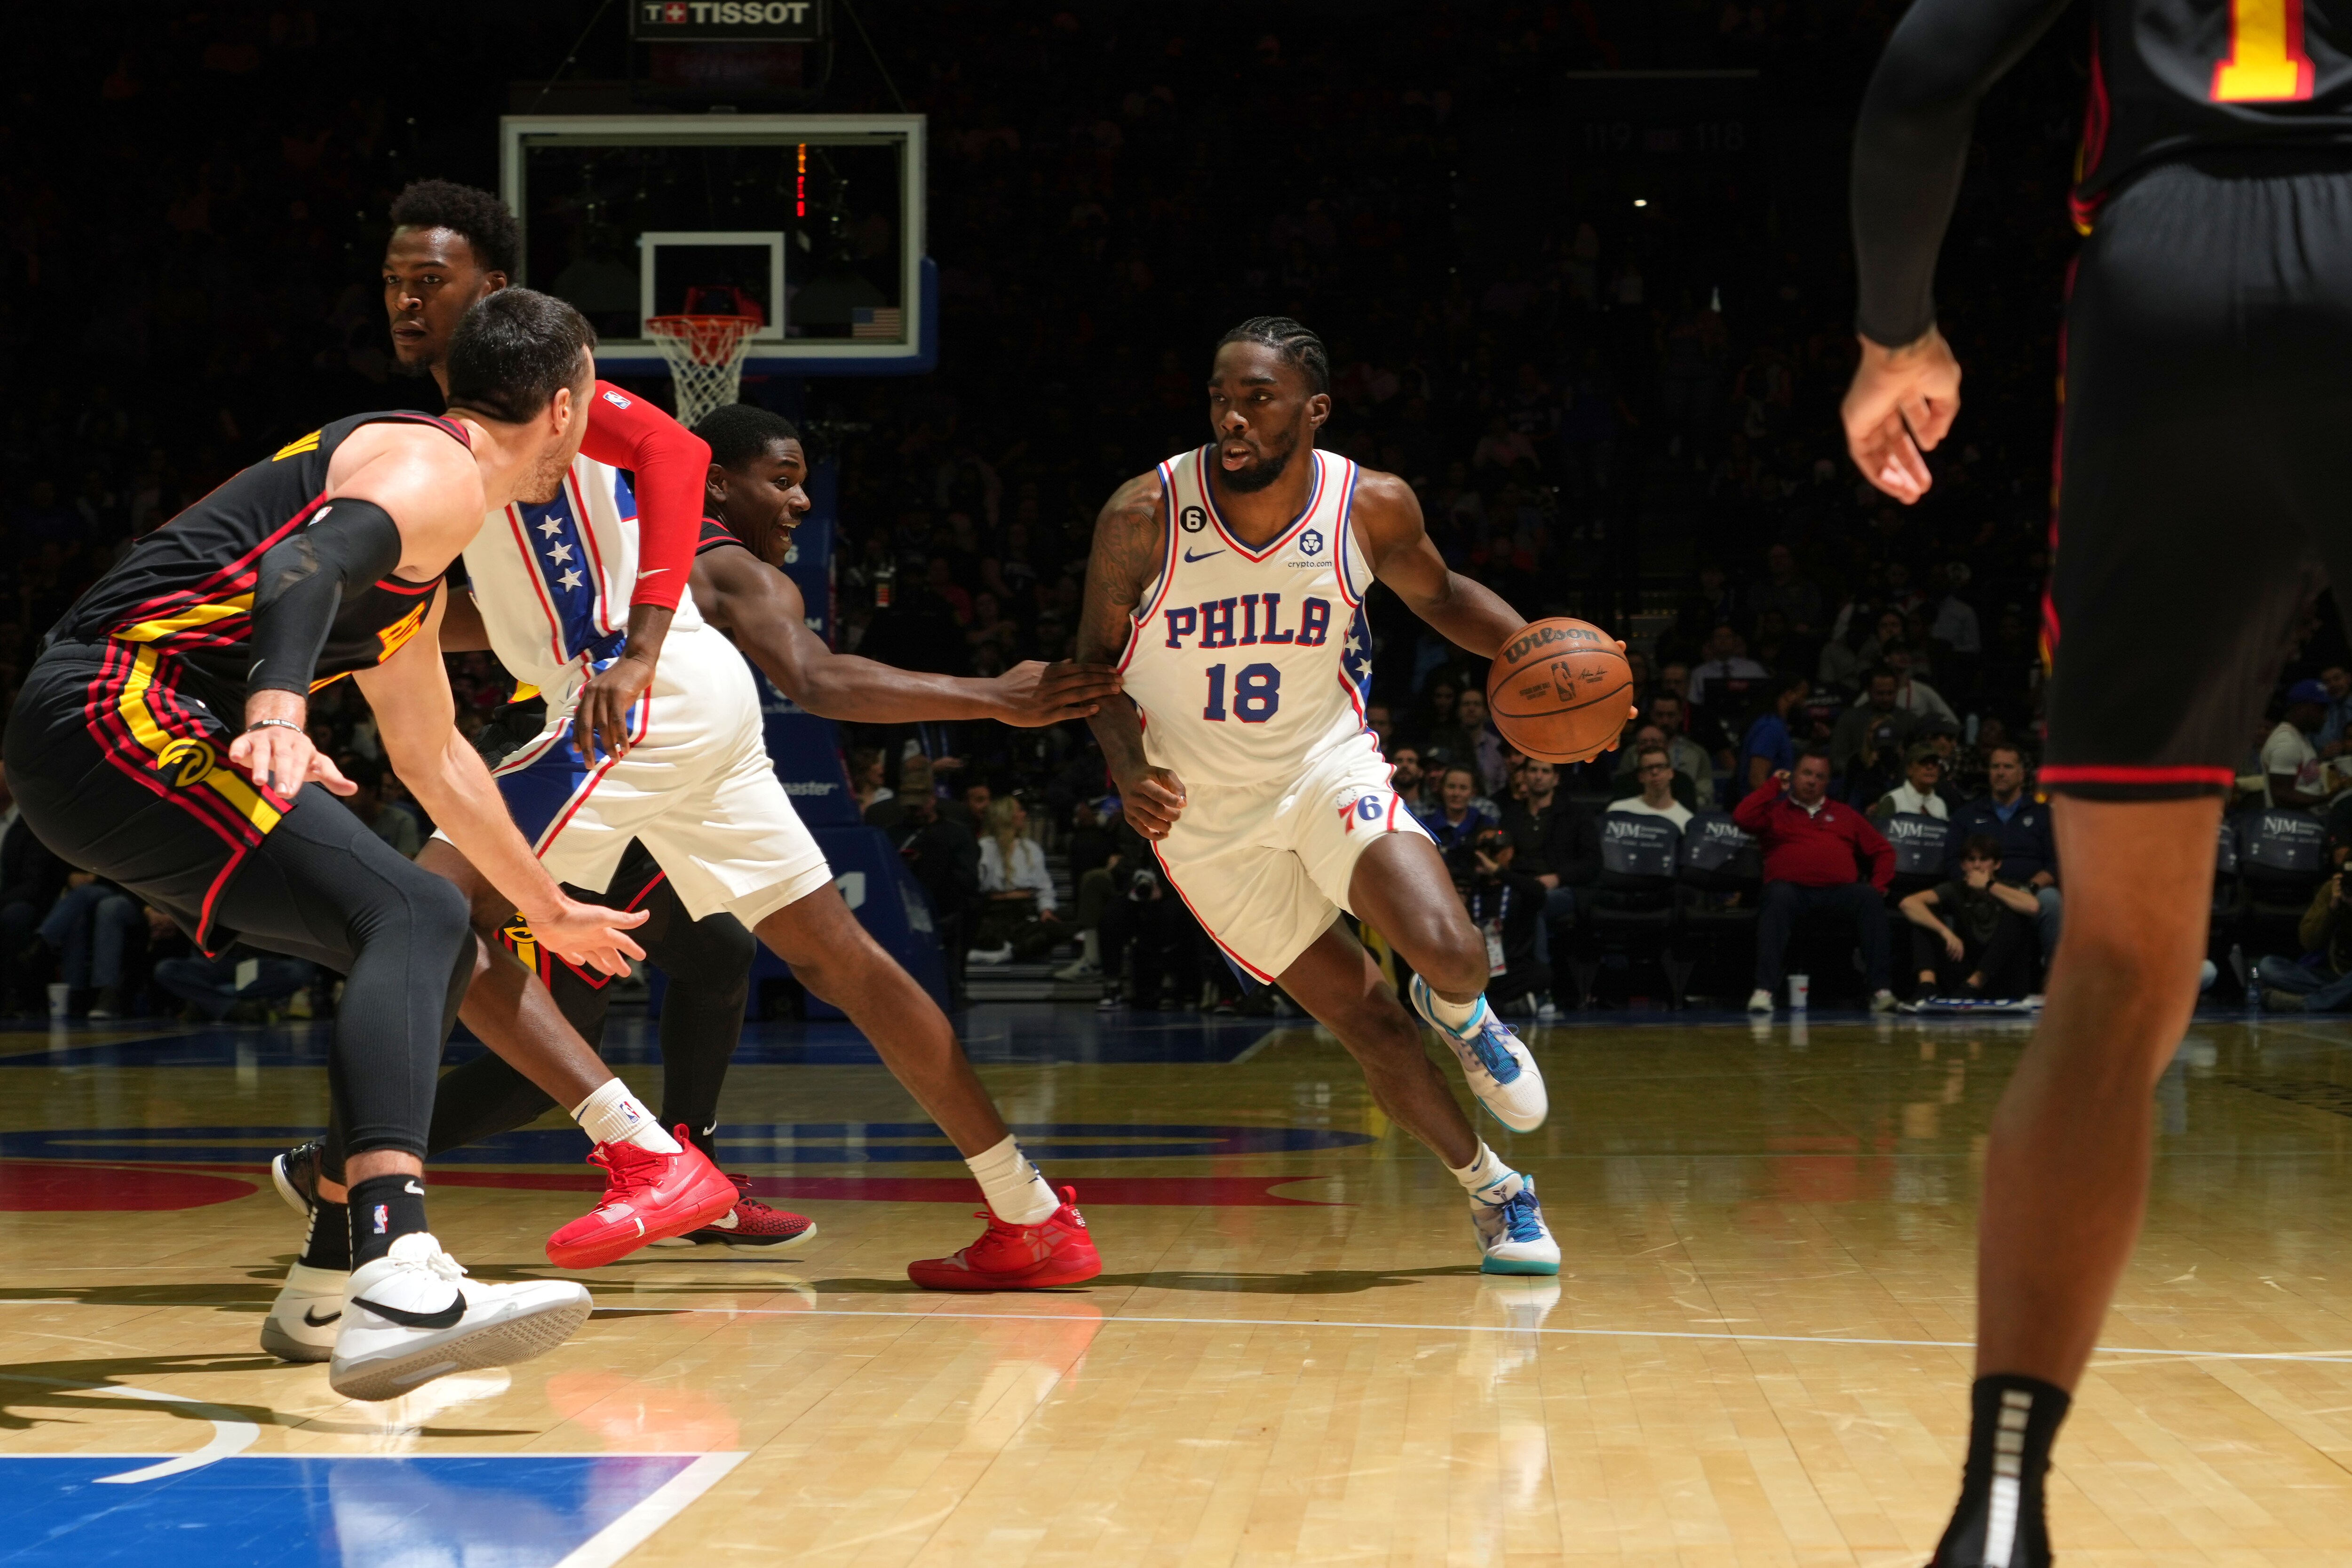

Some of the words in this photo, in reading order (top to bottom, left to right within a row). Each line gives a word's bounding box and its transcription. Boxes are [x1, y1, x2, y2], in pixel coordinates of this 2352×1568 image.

[689, 2, 810, 24] TISSOT
[1584, 121, 1632, 151] 119
[1696, 120, 1744, 151] 118
[1186, 509, 1201, 529] 6
[1164, 593, 1331, 649] PHILA
[1203, 663, 1281, 724] 18
[1337, 795, 1383, 836] 76
[2263, 816, 2297, 834] NJM
[1605, 820, 1640, 838] NJM
[1705, 821, 1739, 838] NJM
[1889, 819, 1923, 838] NJM
